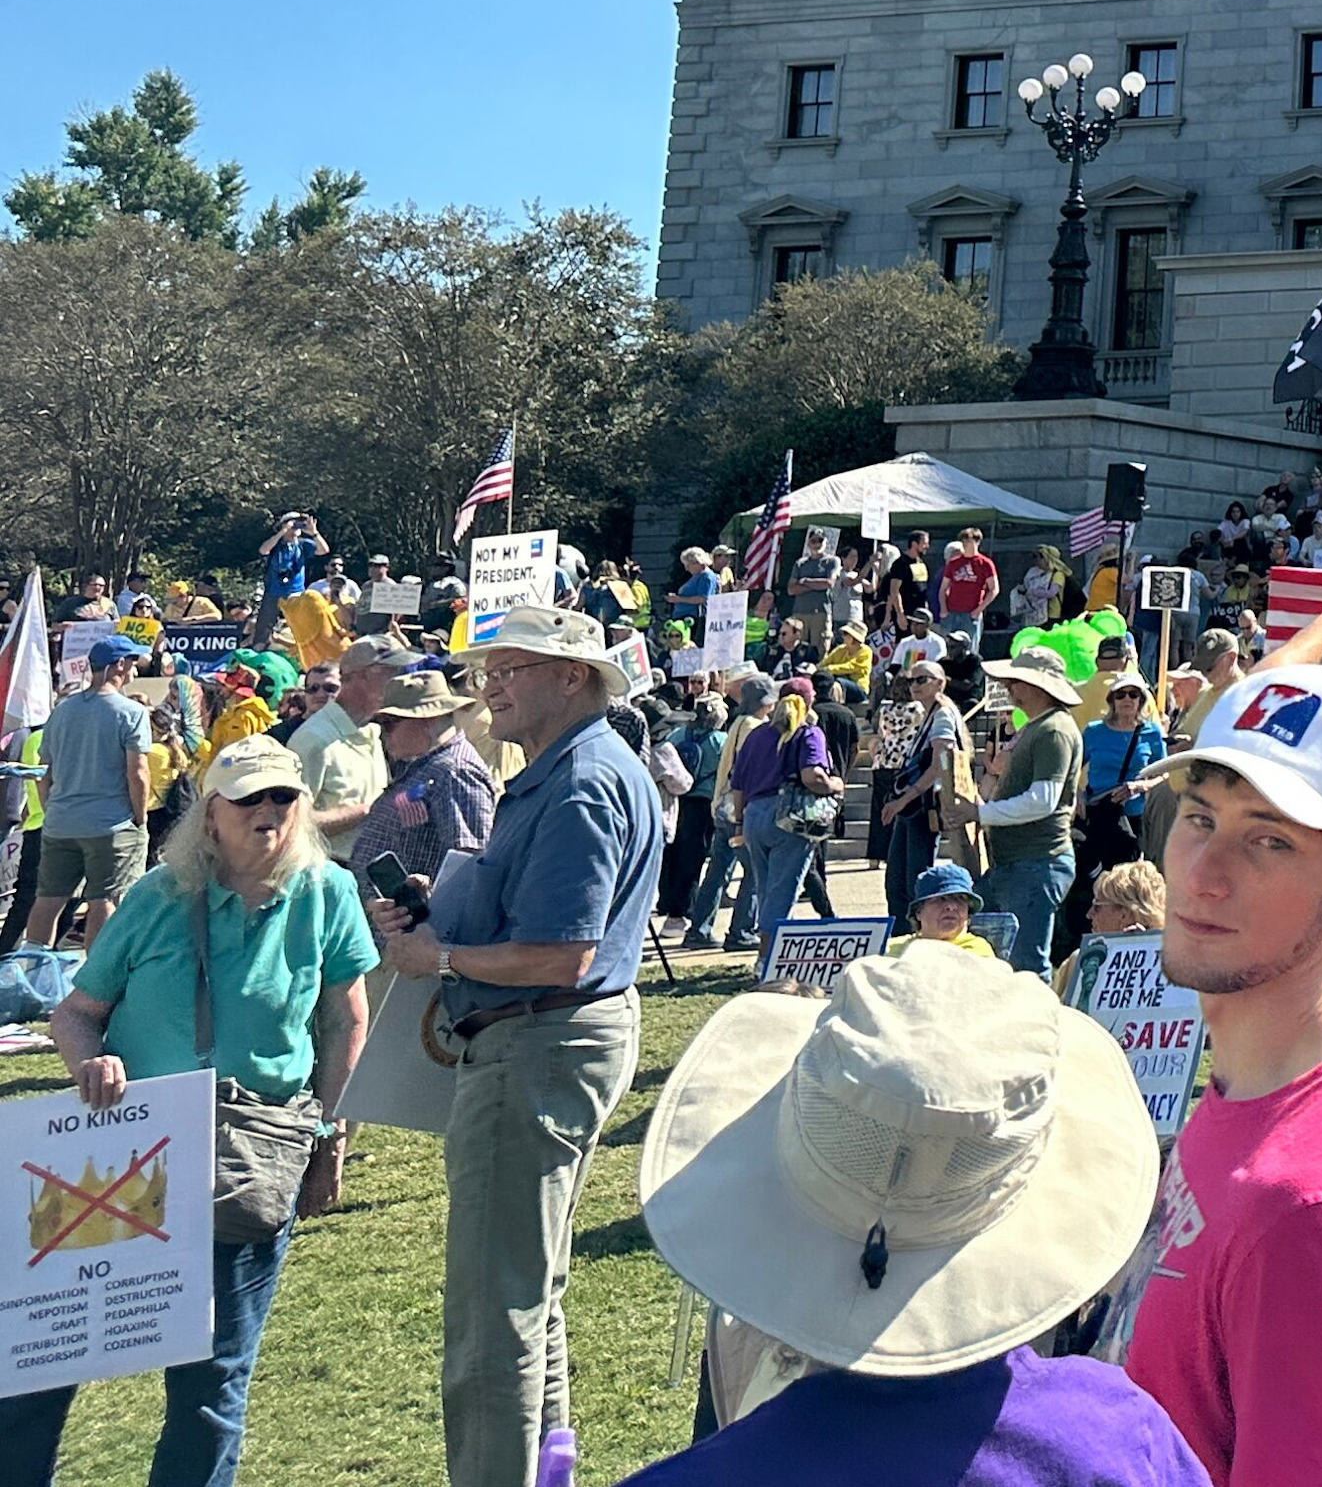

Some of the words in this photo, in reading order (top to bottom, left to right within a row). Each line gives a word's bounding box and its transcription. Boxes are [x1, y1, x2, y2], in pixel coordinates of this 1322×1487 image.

[475, 548, 497, 563] NOT
[502, 546, 520, 561] MY
[475, 566, 537, 584] PRESIDENT.
[474, 598, 489, 612] NO
[126, 622, 145, 633] NO
[709, 622, 723, 632] ALL
[163, 637, 189, 650] NO
[778, 937, 869, 959] IMPEACH
[1107, 950, 1147, 971] AND
[775, 963, 842, 986] TRUMP
[1104, 969, 1151, 989] THEY
[1097, 990, 1131, 1009] FOR
[1138, 988, 1164, 1007] ME
[1120, 1019, 1194, 1050] SAVE
[48, 1115, 80, 1135] NO
[86, 1103, 149, 1130] KINGS
[79, 1260, 111, 1281] NO
[104, 1269, 179, 1292] CORRUPTION
[104, 1283, 183, 1307] DESTRUCTION
[28, 1301, 89, 1322] NEPOTISM
[51, 1317, 88, 1333] GRAFT
[104, 1318, 158, 1337] HOAXING
[11, 1332, 89, 1356] RETRIBUTION
[104, 1332, 162, 1352] COZENING
[16, 1346, 89, 1370] CENSORSHIP
